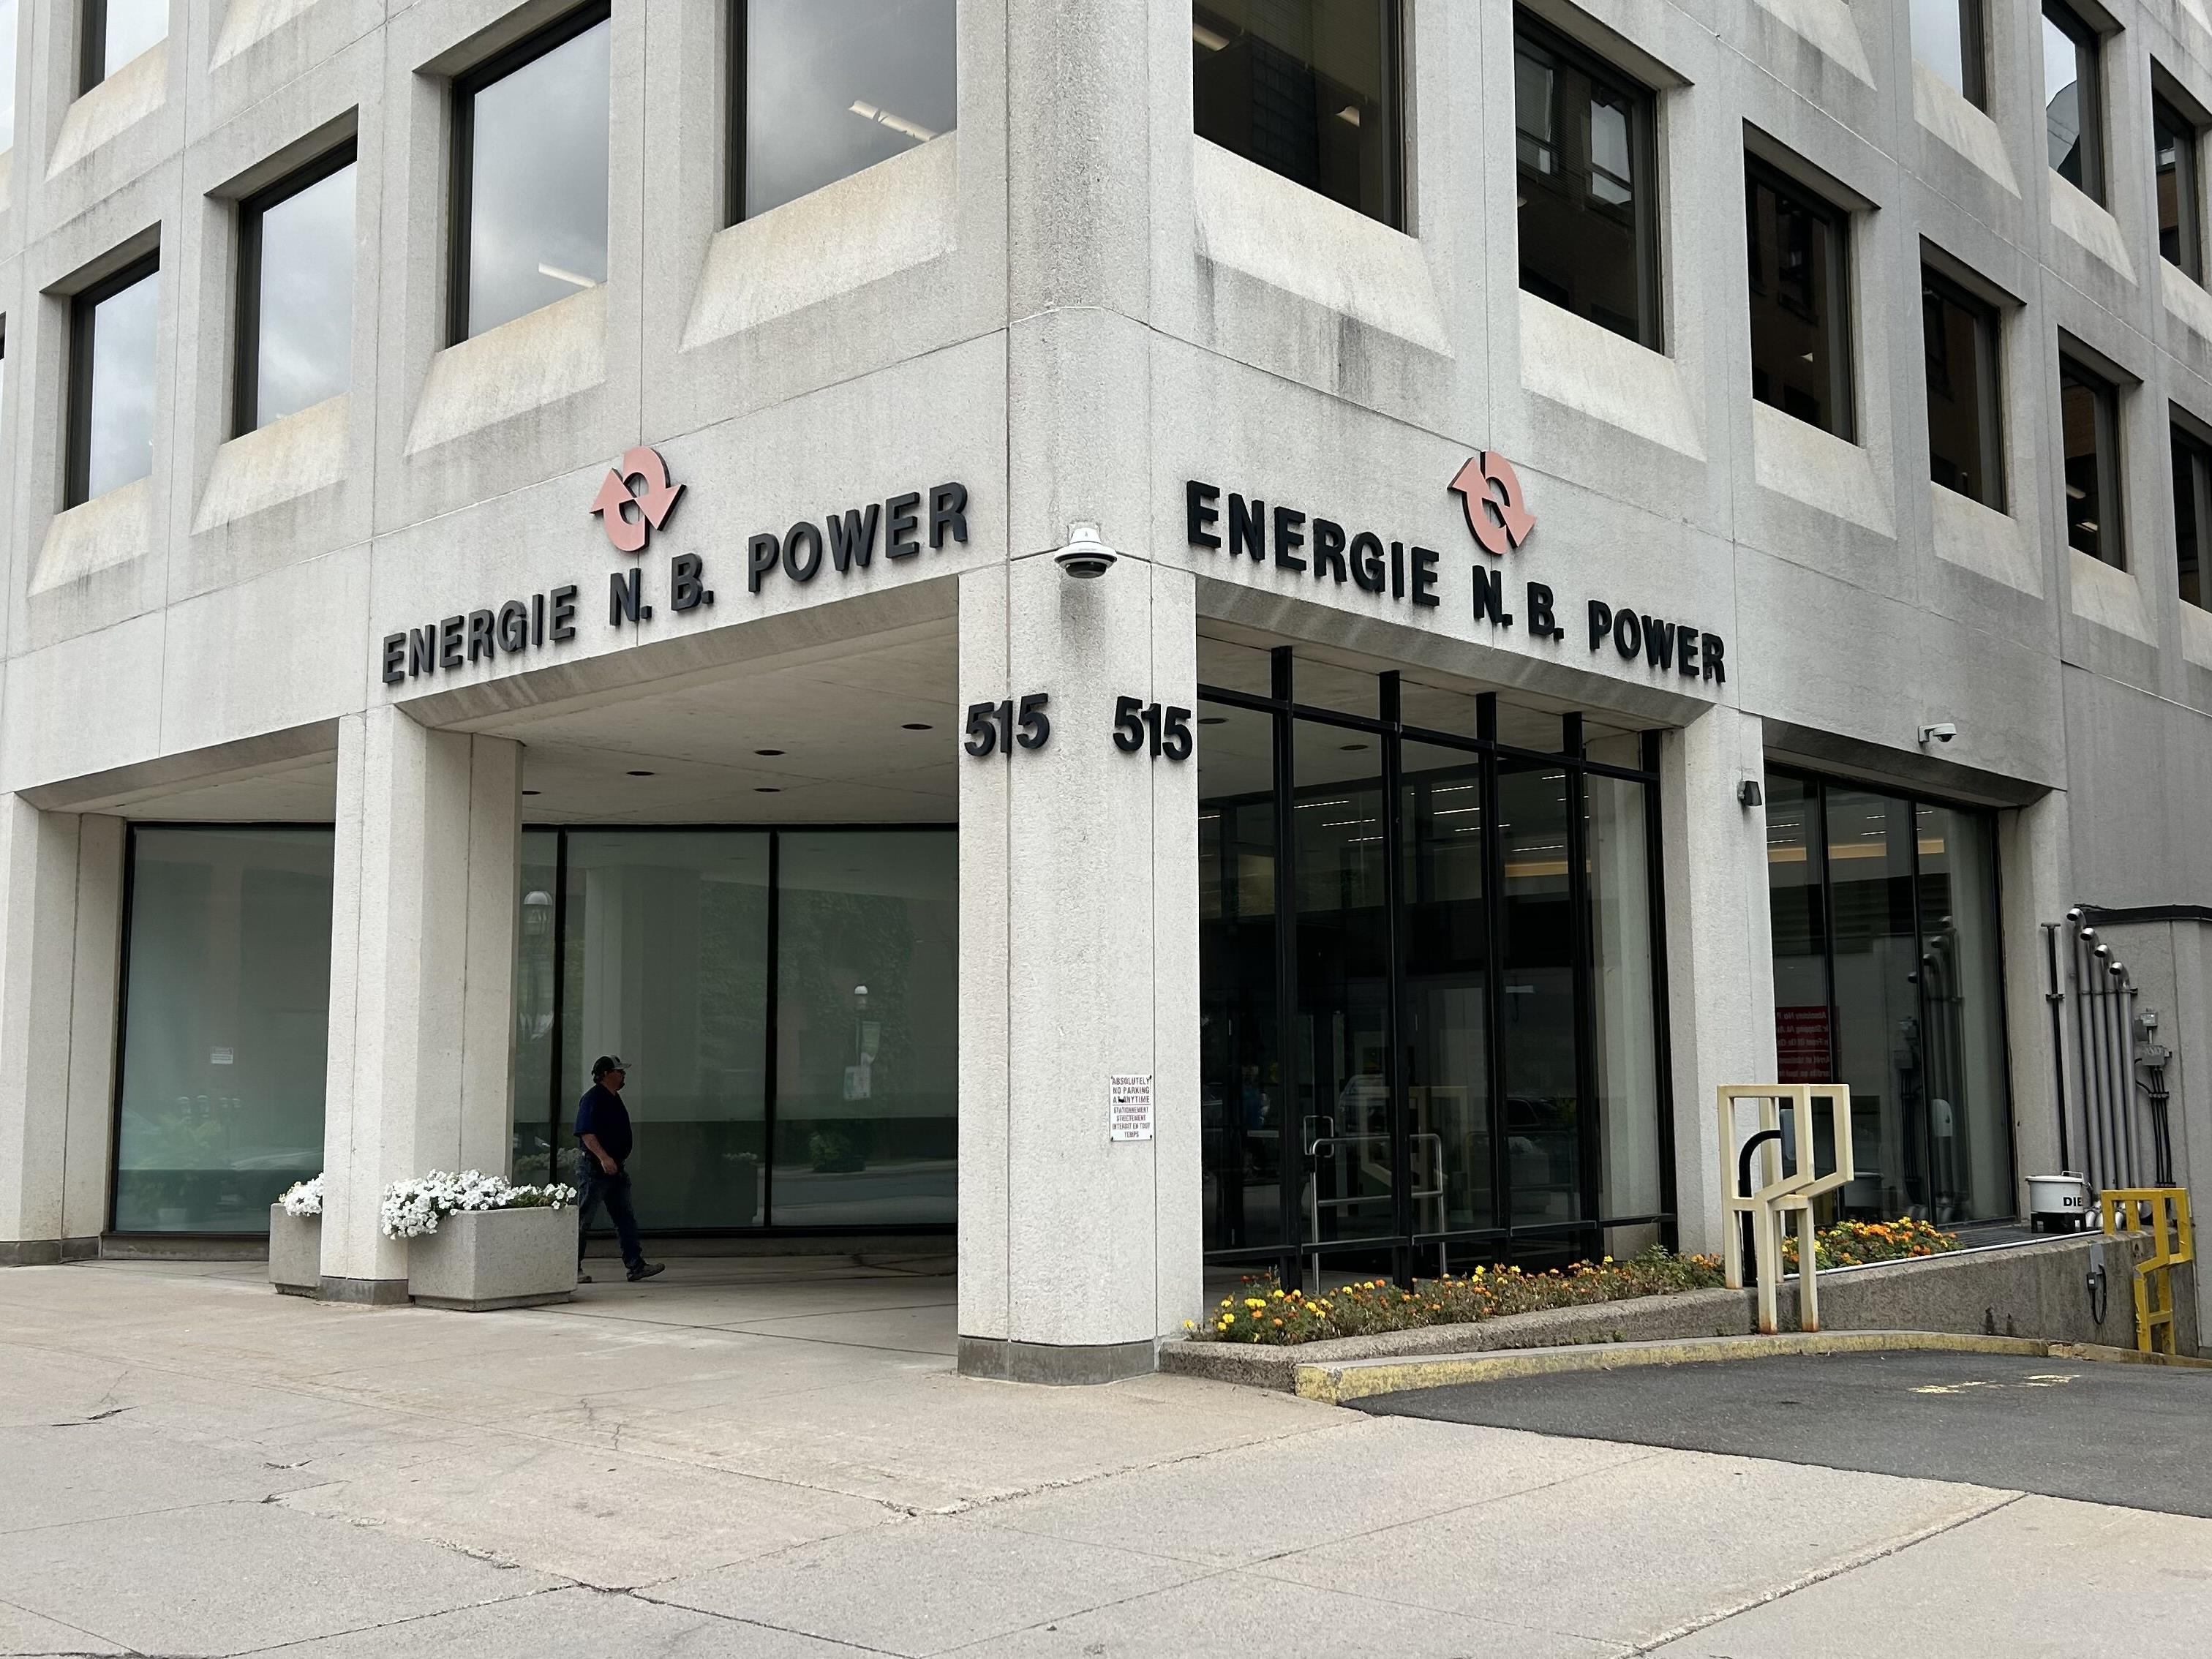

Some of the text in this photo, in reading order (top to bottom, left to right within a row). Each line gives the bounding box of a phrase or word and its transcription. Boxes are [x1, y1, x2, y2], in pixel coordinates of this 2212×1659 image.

[383, 481, 968, 683] ENERGIE N. B. POWER
[1186, 480, 1726, 683] ENERGIE N. B. POWER
[964, 693, 1050, 756] 515
[1113, 696, 1193, 761] 515
[1112, 1077, 1150, 1085] ABSOLUTELY
[1113, 1086, 1150, 1094] NO PARKING
